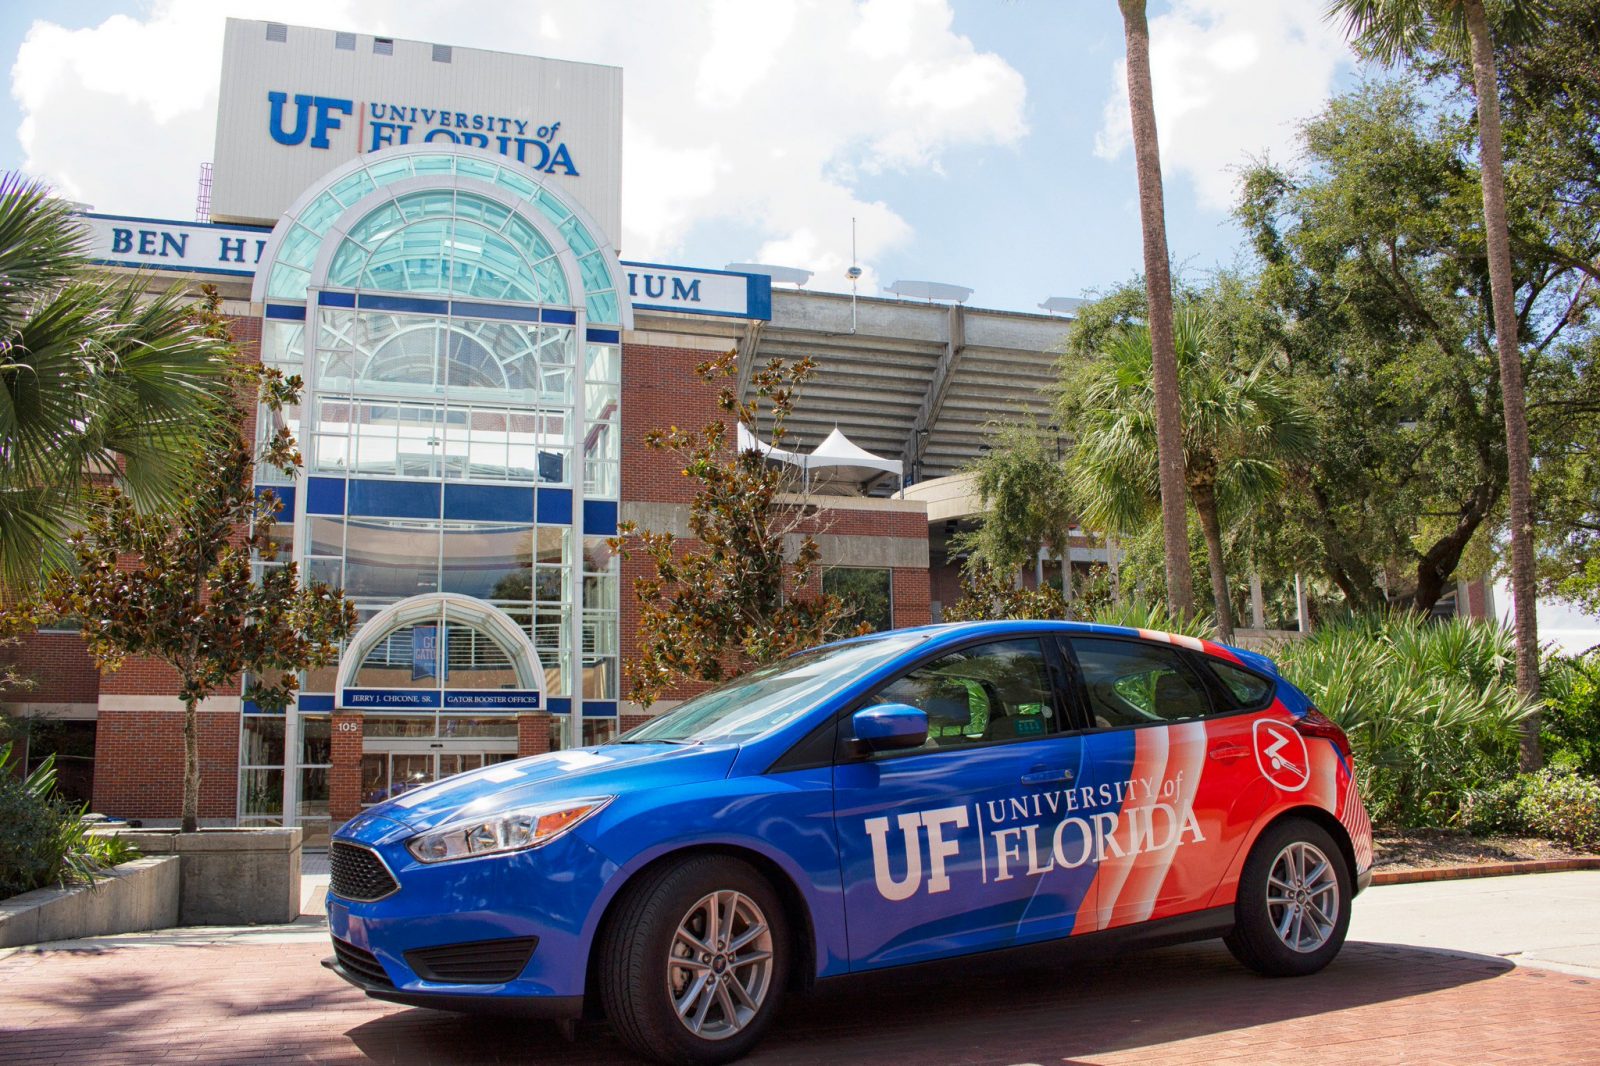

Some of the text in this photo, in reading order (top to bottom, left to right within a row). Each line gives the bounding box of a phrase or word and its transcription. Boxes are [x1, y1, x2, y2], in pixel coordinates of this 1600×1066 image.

[268, 91, 353, 149] UF
[370, 103, 561, 143] UNIVERSITY of
[111, 228, 190, 258] BEN
[627, 273, 702, 301] IUM
[352, 694, 375, 703] JERRY
[447, 695, 474, 703] GATOR
[474, 695, 507, 703] BOOSTER
[507, 696, 537, 704] OFFICES
[338, 722, 358, 732] 105
[987, 770, 1184, 823] UNIVERSITY of
[864, 805, 969, 901] UF
[990, 799, 1206, 882] FLORIDA
